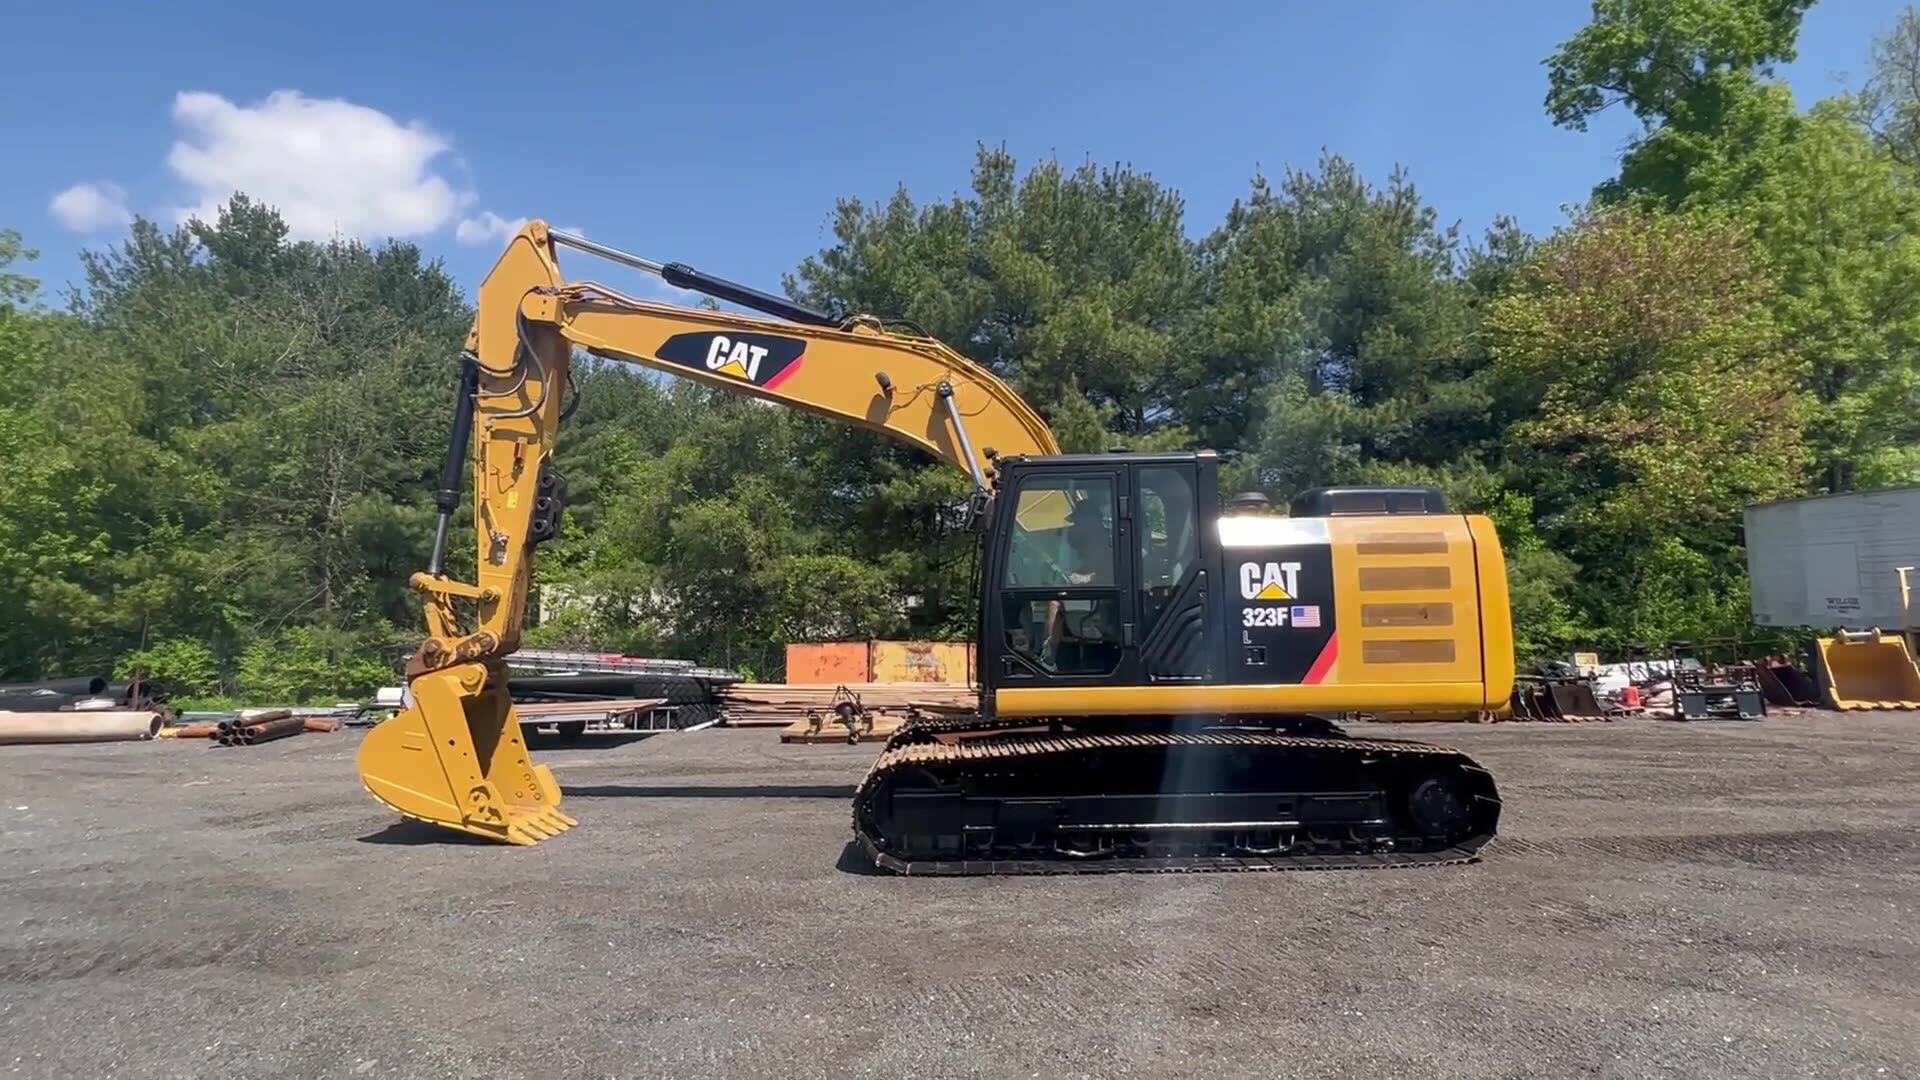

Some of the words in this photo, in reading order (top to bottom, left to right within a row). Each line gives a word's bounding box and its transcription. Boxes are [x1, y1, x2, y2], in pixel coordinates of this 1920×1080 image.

[706, 336, 769, 381] CAT
[1240, 562, 1301, 599] CAT
[1242, 607, 1289, 627] 323F
[1242, 630, 1252, 645] L
